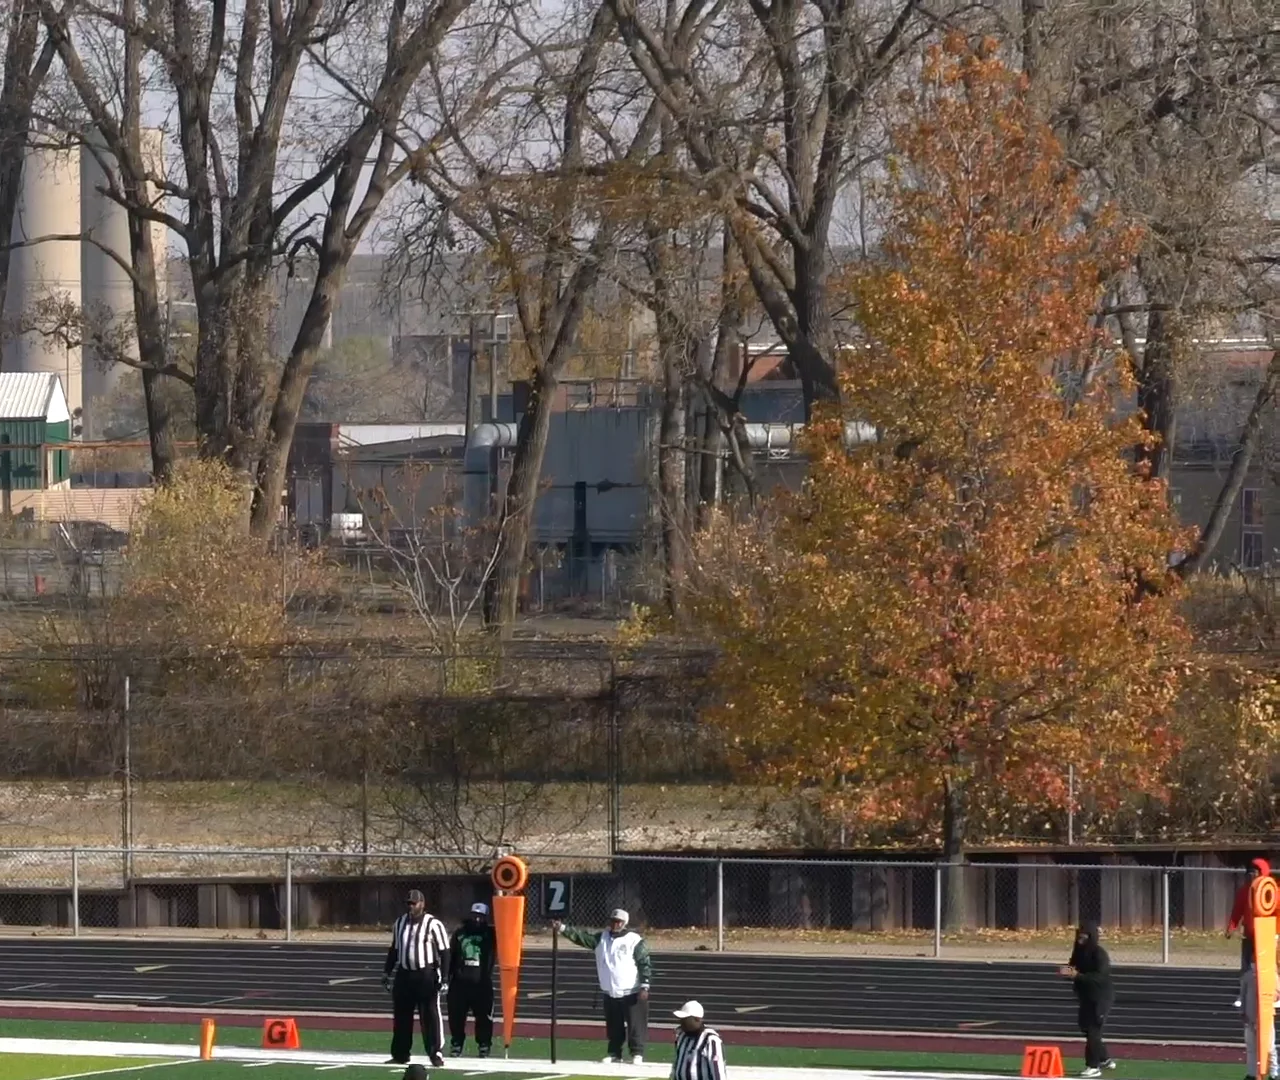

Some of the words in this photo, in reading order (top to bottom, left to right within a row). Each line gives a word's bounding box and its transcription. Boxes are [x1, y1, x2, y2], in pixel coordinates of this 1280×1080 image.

[549, 880, 566, 911] 2
[267, 1020, 288, 1045] G
[1027, 1048, 1053, 1076] 10
